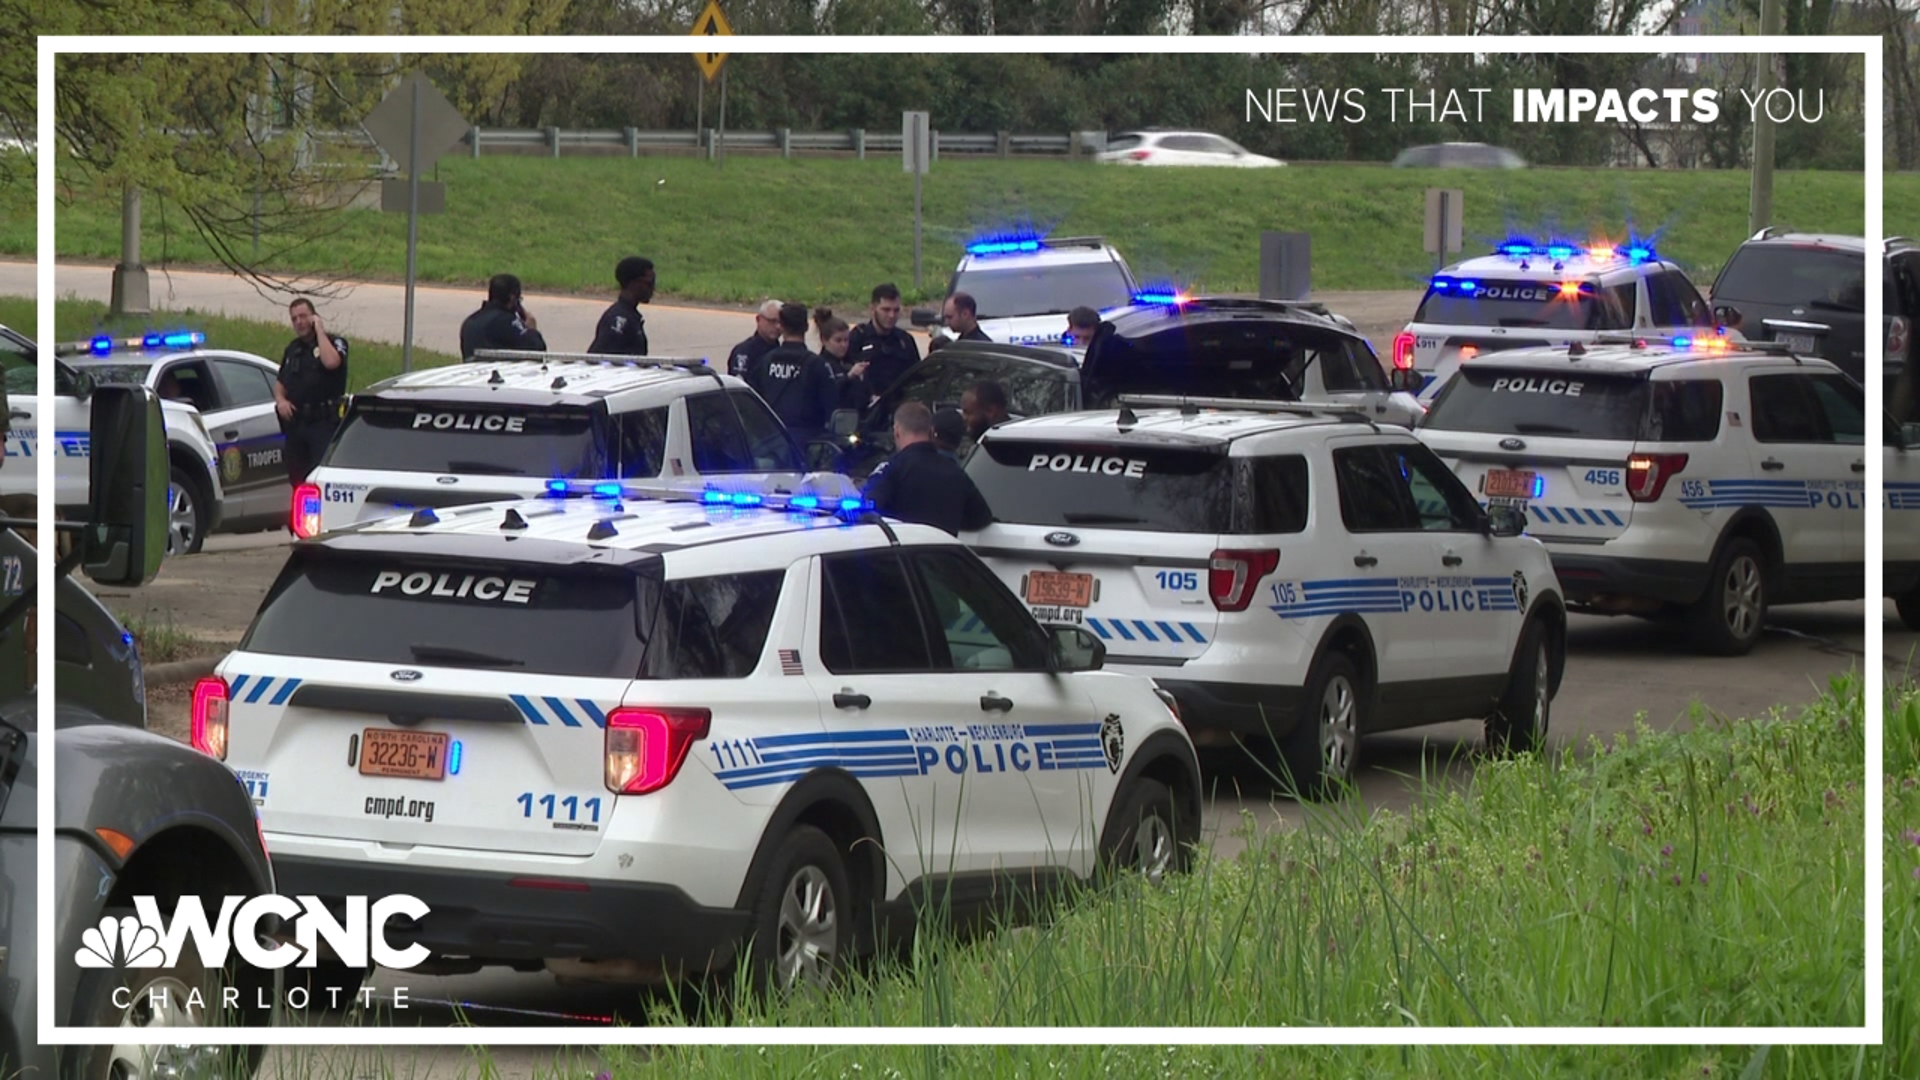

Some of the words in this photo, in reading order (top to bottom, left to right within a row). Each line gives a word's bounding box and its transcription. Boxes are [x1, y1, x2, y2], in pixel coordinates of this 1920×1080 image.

[1473, 285, 1550, 301] POLICE
[1009, 333, 1062, 344] POLIC
[1492, 377, 1584, 397] POLICE
[412, 412, 526, 433] POLICE
[247, 449, 283, 469] TROOPER
[1028, 453, 1147, 479] POLICE
[1585, 469, 1620, 486] 456
[333, 490, 354, 503] 911
[1680, 480, 1704, 498] 456
[3, 555, 22, 594] 72
[1155, 571, 1198, 590] 105
[371, 571, 537, 603] POLICE
[1270, 582, 1297, 604] 105
[1402, 589, 1490, 612] POLICE
[1032, 605, 1082, 624] cmpd.org
[366, 732, 398, 741] NORTH
[401, 734, 444, 745] CAROLINA
[368, 741, 438, 769] 32236-W
[710, 738, 760, 769] 1111
[916, 742, 1056, 776] POLICE
[246, 780, 269, 797] 11
[364, 796, 435, 823] cmpd.org
[517, 792, 601, 822] 1111
